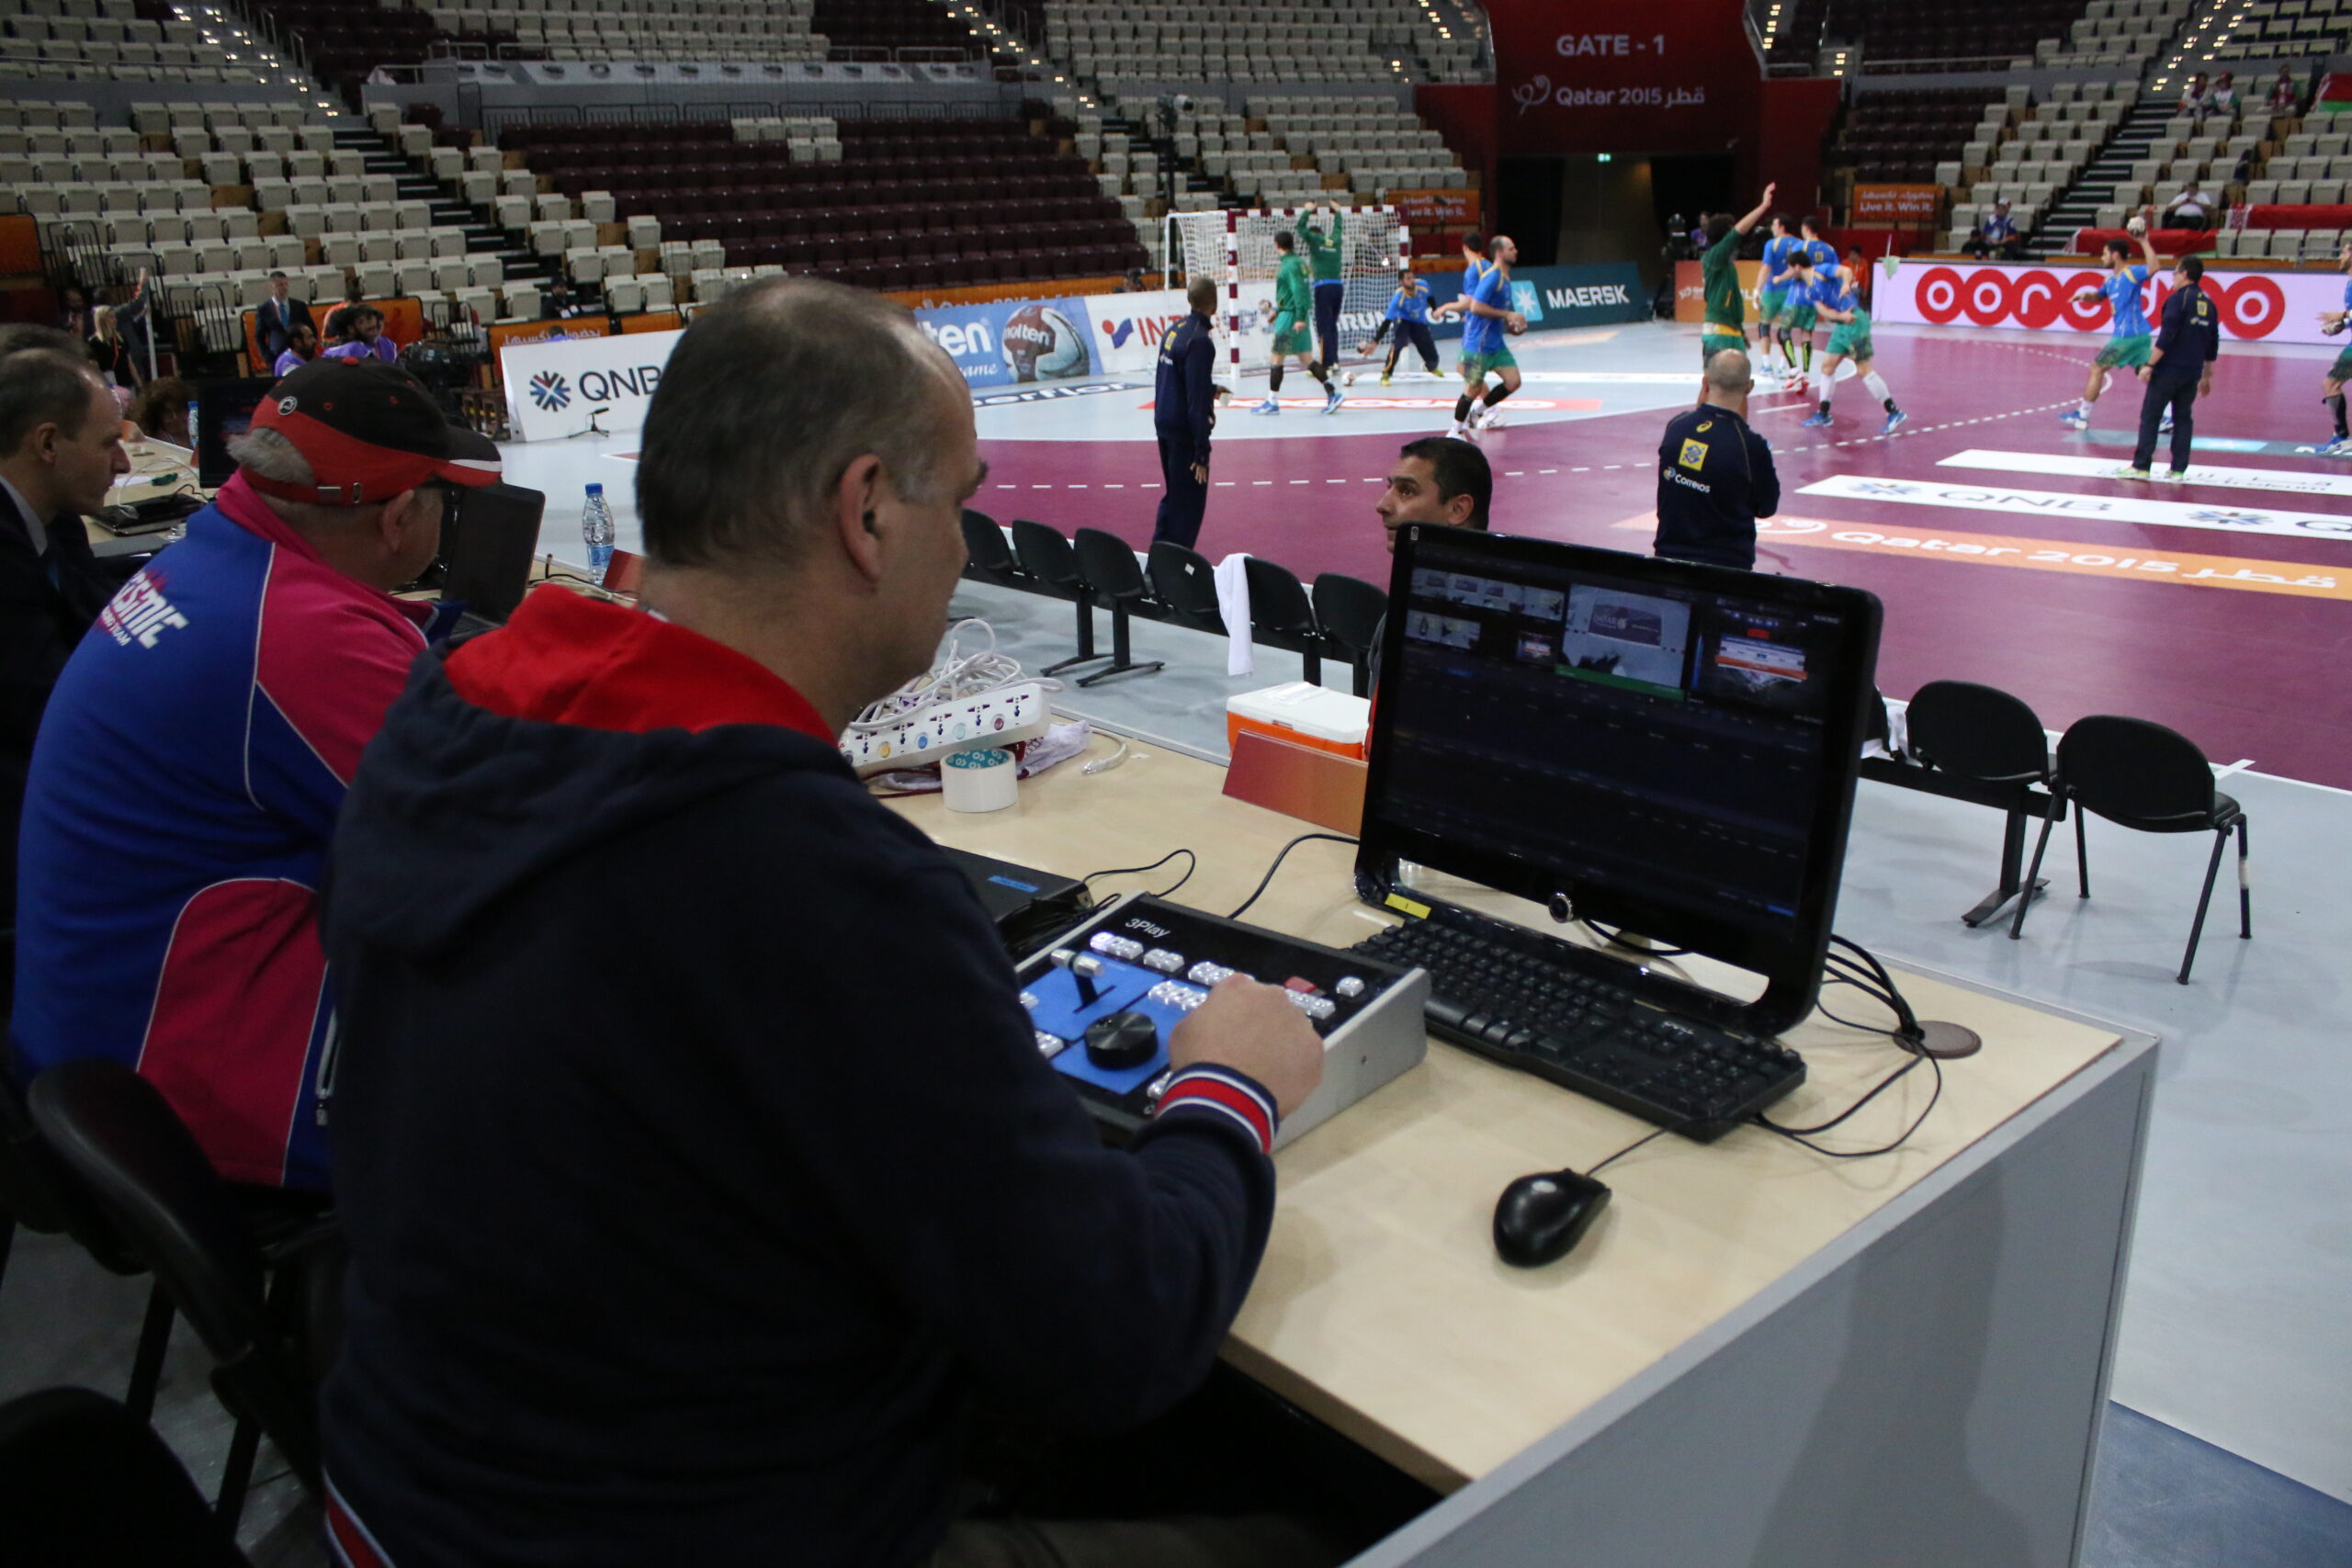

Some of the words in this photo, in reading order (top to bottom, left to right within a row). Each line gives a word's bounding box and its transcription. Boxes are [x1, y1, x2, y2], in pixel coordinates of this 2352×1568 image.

[1556, 34, 1630, 56] GATE
[1652, 34, 1665, 55] 1
[1556, 87, 1613, 107] Qatar
[1618, 87, 1662, 105] 2015
[1860, 202, 1883, 212] Live
[1897, 202, 1919, 212] Win
[1545, 284, 1631, 310] MAERSK
[579, 366, 662, 402] QNB
[1675, 474, 1712, 494] Correios
[1938, 490, 2112, 512] QNB
[1831, 530, 2022, 557] Qatar
[2027, 549, 2181, 573] 2015
[2181, 568, 2336, 589] قطر
[1125, 918, 1171, 938] 3Play
